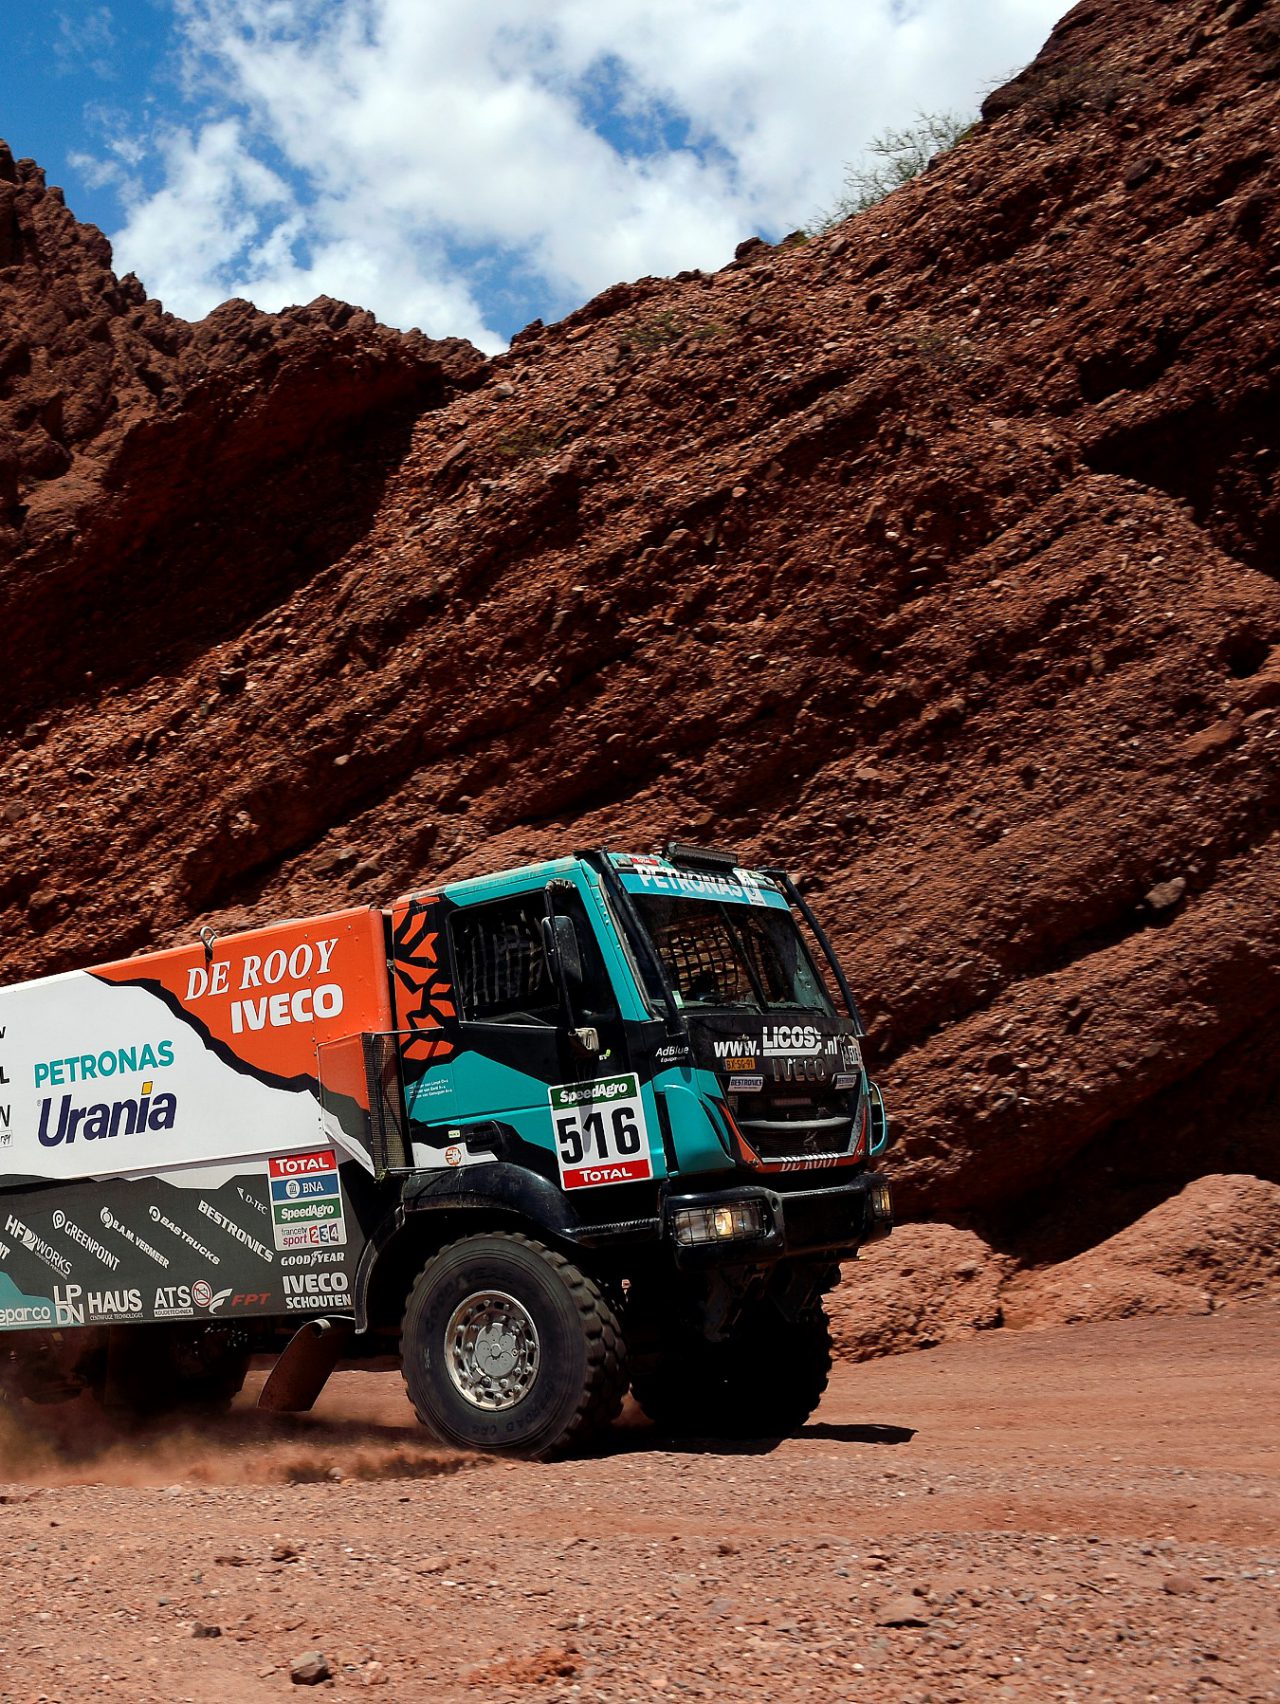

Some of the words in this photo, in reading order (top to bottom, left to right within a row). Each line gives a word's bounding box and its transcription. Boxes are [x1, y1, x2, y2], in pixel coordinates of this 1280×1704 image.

[633, 864, 743, 898] PETRONAS
[184, 961, 230, 1001] DE
[239, 938, 339, 990] ROOY
[230, 983, 344, 1034] IVECO
[655, 1046, 689, 1057] AdBlue
[34, 1040, 175, 1088] PETRONAS
[771, 1058, 826, 1082] IVECO
[559, 1081, 628, 1104] SpeedAgro
[37, 1081, 177, 1147] Urania
[556, 1106, 641, 1164] 516
[302, 1181, 324, 1194] BNA
[245, 1194, 269, 1215] D-TEC
[281, 1204, 334, 1221] SpeedAgro
[160, 1216, 182, 1236] BAS
[181, 1232, 221, 1265] TRUCKS
[197, 1200, 274, 1263] BESTRONICS
[283, 1233, 307, 1247] sport
[4, 1214, 26, 1239] HF
[36, 1240, 73, 1276] WORKS
[64, 1221, 120, 1271] GREENPOINT
[112, 1220, 135, 1243] B.A.M.
[134, 1236, 170, 1269] VERMEER
[281, 1251, 344, 1267] GOODYEAR
[282, 1272, 348, 1294] IVECO
[88, 1289, 143, 1313] HAUS
[154, 1286, 192, 1308] ATS
[231, 1293, 271, 1307] FPT
[286, 1294, 352, 1309] SCHOUTEN
